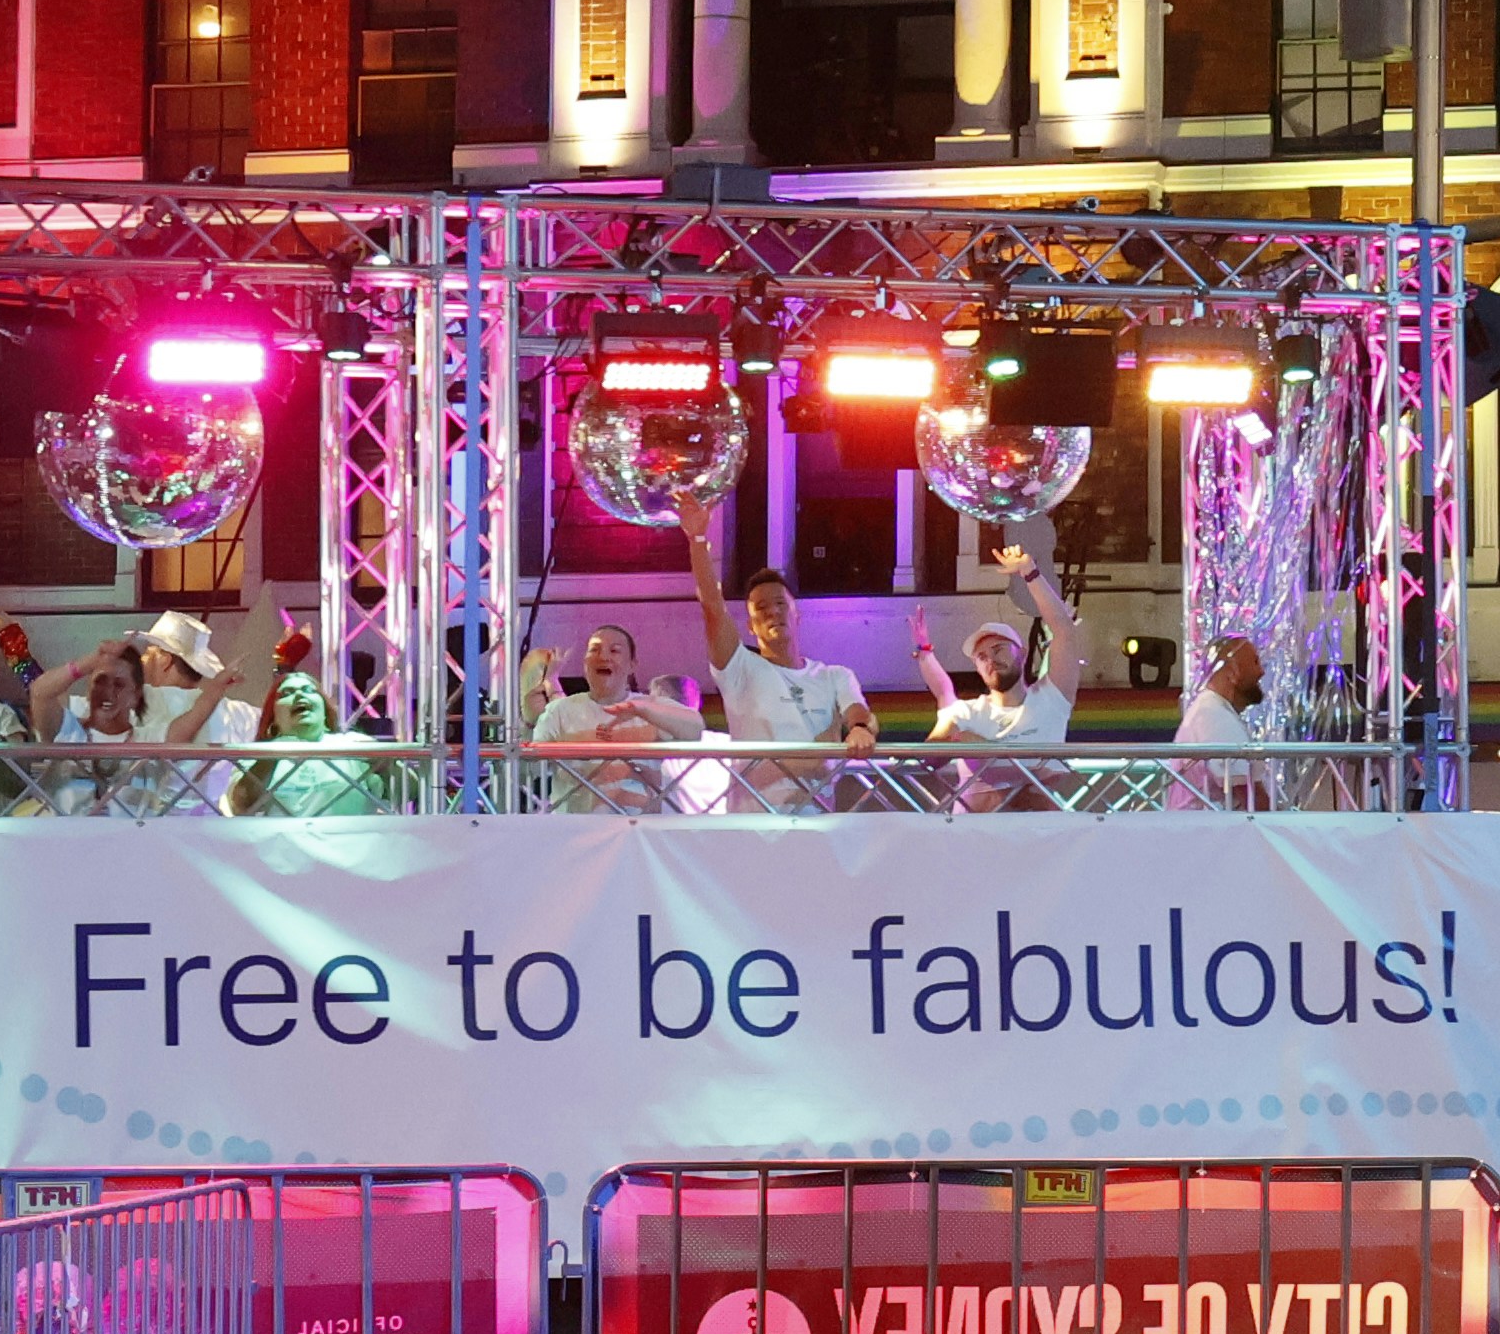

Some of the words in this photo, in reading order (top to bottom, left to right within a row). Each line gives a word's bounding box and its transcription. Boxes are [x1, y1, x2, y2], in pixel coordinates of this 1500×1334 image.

[75, 922, 391, 1048] Free
[446, 929, 581, 1042] to
[637, 914, 800, 1039] be
[852, 907, 1460, 1034] fabulous!
[1033, 1171, 1081, 1192] TFH
[24, 1186, 77, 1207] TFH
